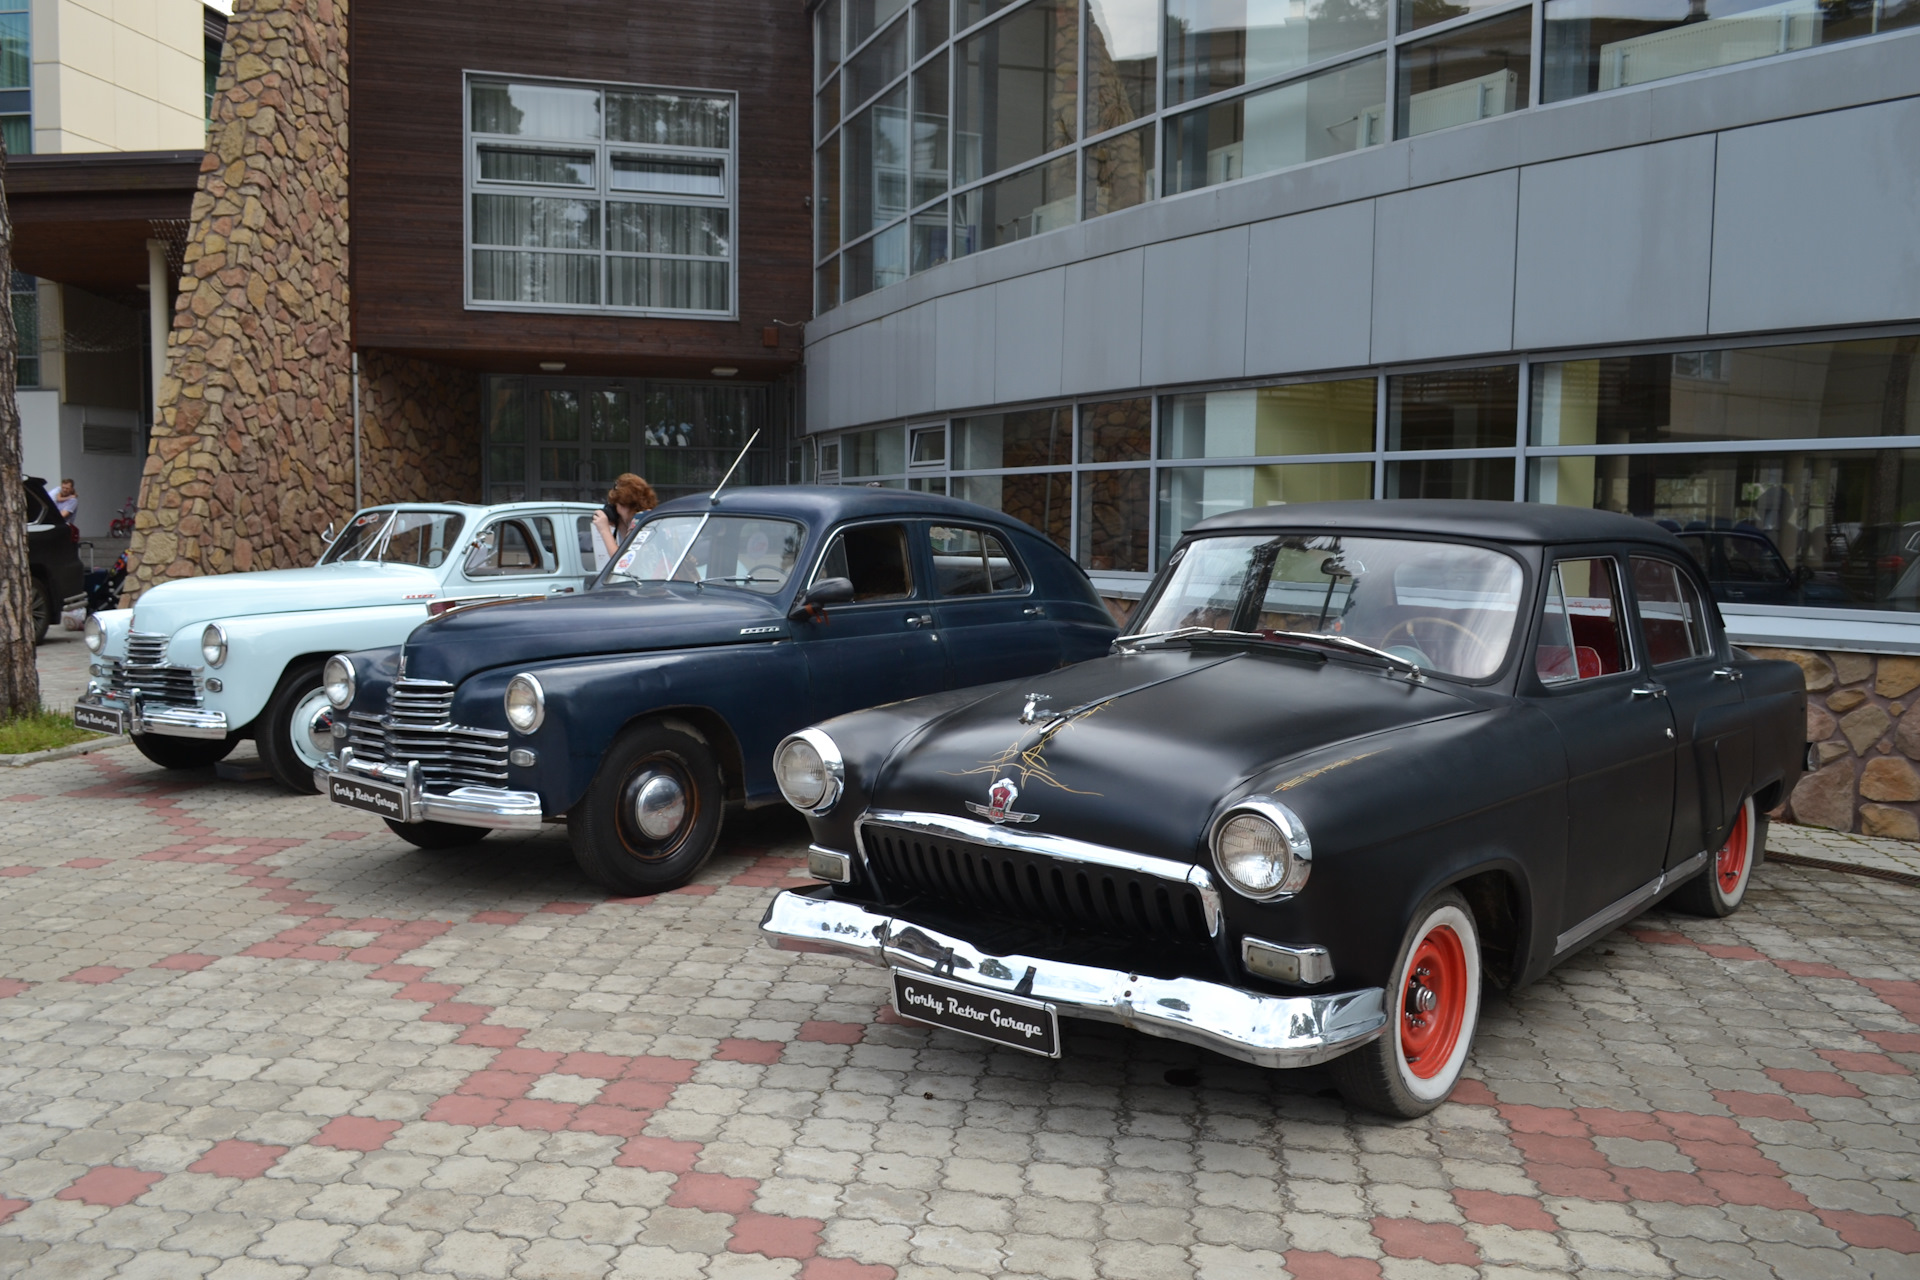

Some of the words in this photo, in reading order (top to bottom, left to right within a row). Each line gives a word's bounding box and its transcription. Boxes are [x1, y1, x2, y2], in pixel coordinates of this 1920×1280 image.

[333, 783, 354, 800] Gorky
[355, 788, 375, 802] Retro
[375, 793, 399, 811] Garage
[904, 986, 944, 1015] Gorky
[947, 997, 989, 1022] Retro
[989, 1008, 1043, 1038] Garage
